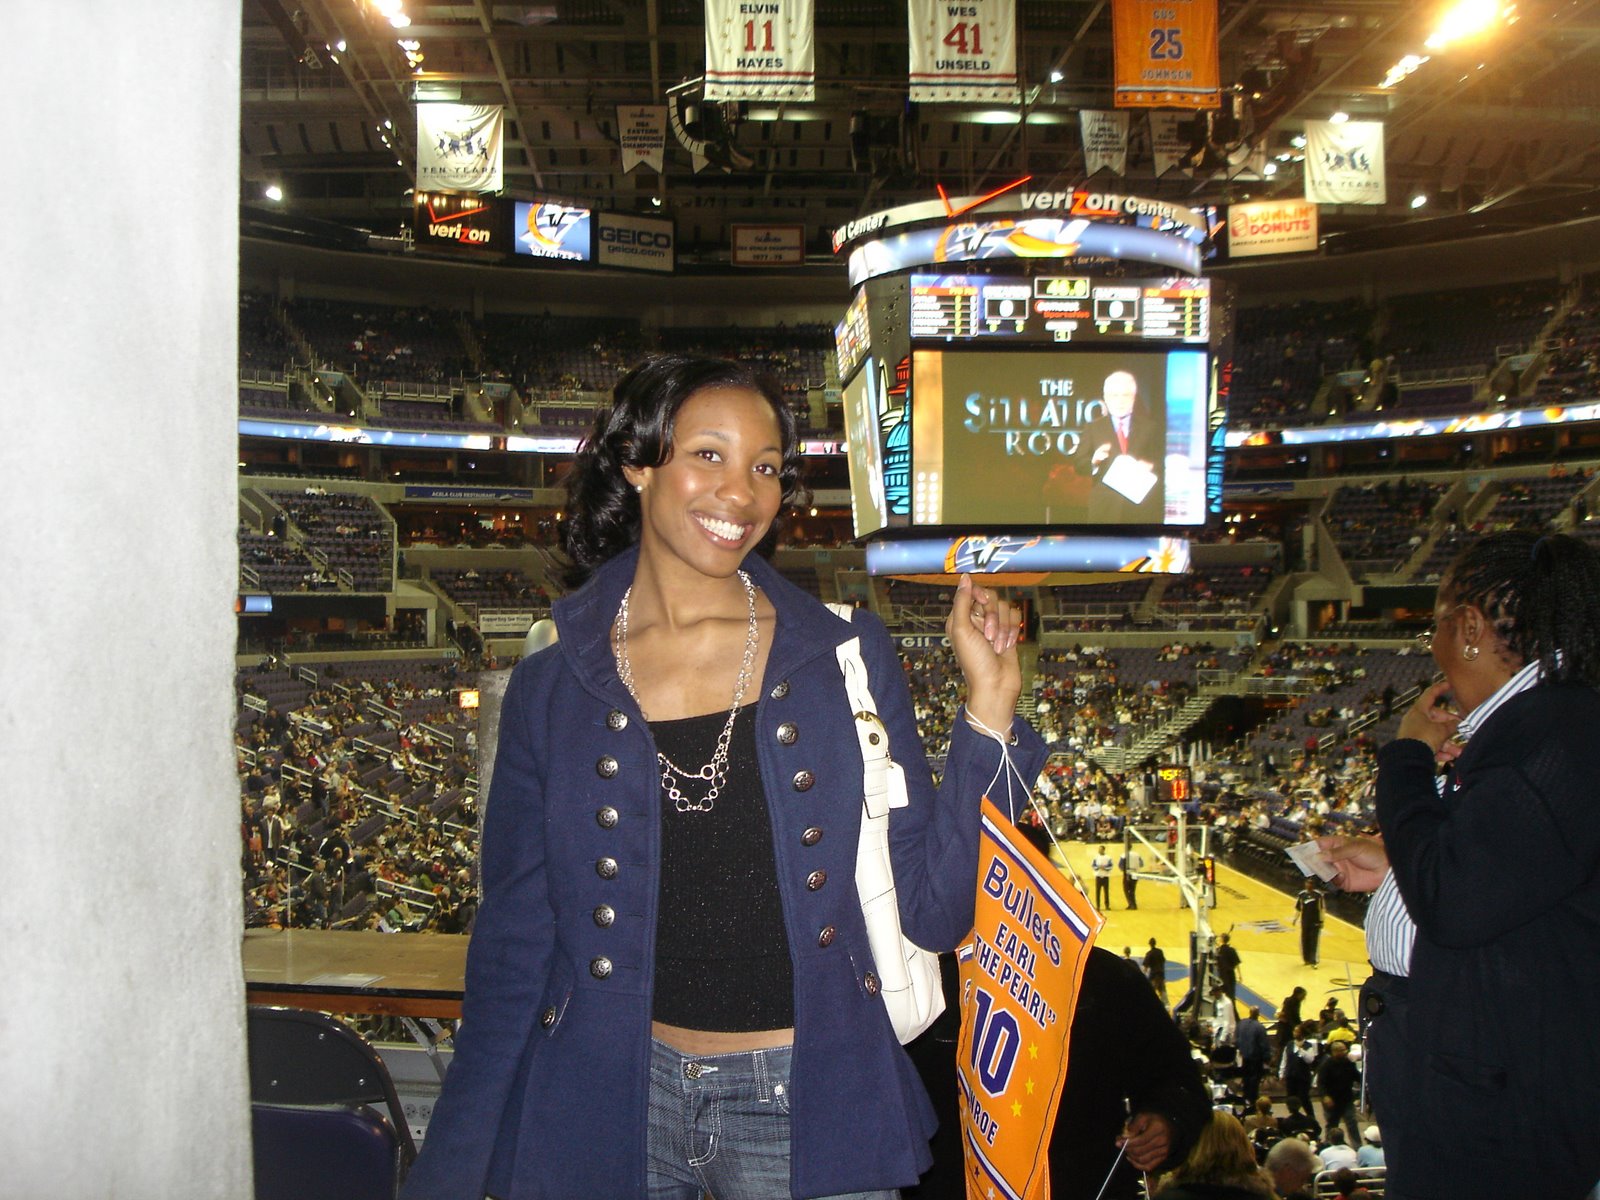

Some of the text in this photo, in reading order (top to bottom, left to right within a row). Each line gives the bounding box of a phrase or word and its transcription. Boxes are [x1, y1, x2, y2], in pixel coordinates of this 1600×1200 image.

[740, 4, 779, 14] ELVIN
[947, 6, 977, 17] WES
[744, 20, 775, 52] 11
[942, 22, 983, 55] 41
[1150, 28, 1184, 60] 25
[736, 58, 784, 68] HAYES
[936, 60, 991, 71] UNSELD
[1142, 69, 1193, 80] JOHNSON
[1021, 186, 1179, 219] verizon Center
[429, 222, 491, 245] verizon
[600, 226, 671, 248] GEICO
[847, 213, 887, 240] Center
[1250, 219, 1310, 235] DONUTS
[607, 243, 666, 259] geico.com
[1040, 379, 1074, 396] THE
[1005, 431, 1081, 456] ROO
[983, 854, 1062, 968] Bullets
[994, 922, 1037, 982] EARL
[970, 986, 1022, 1098] 10
